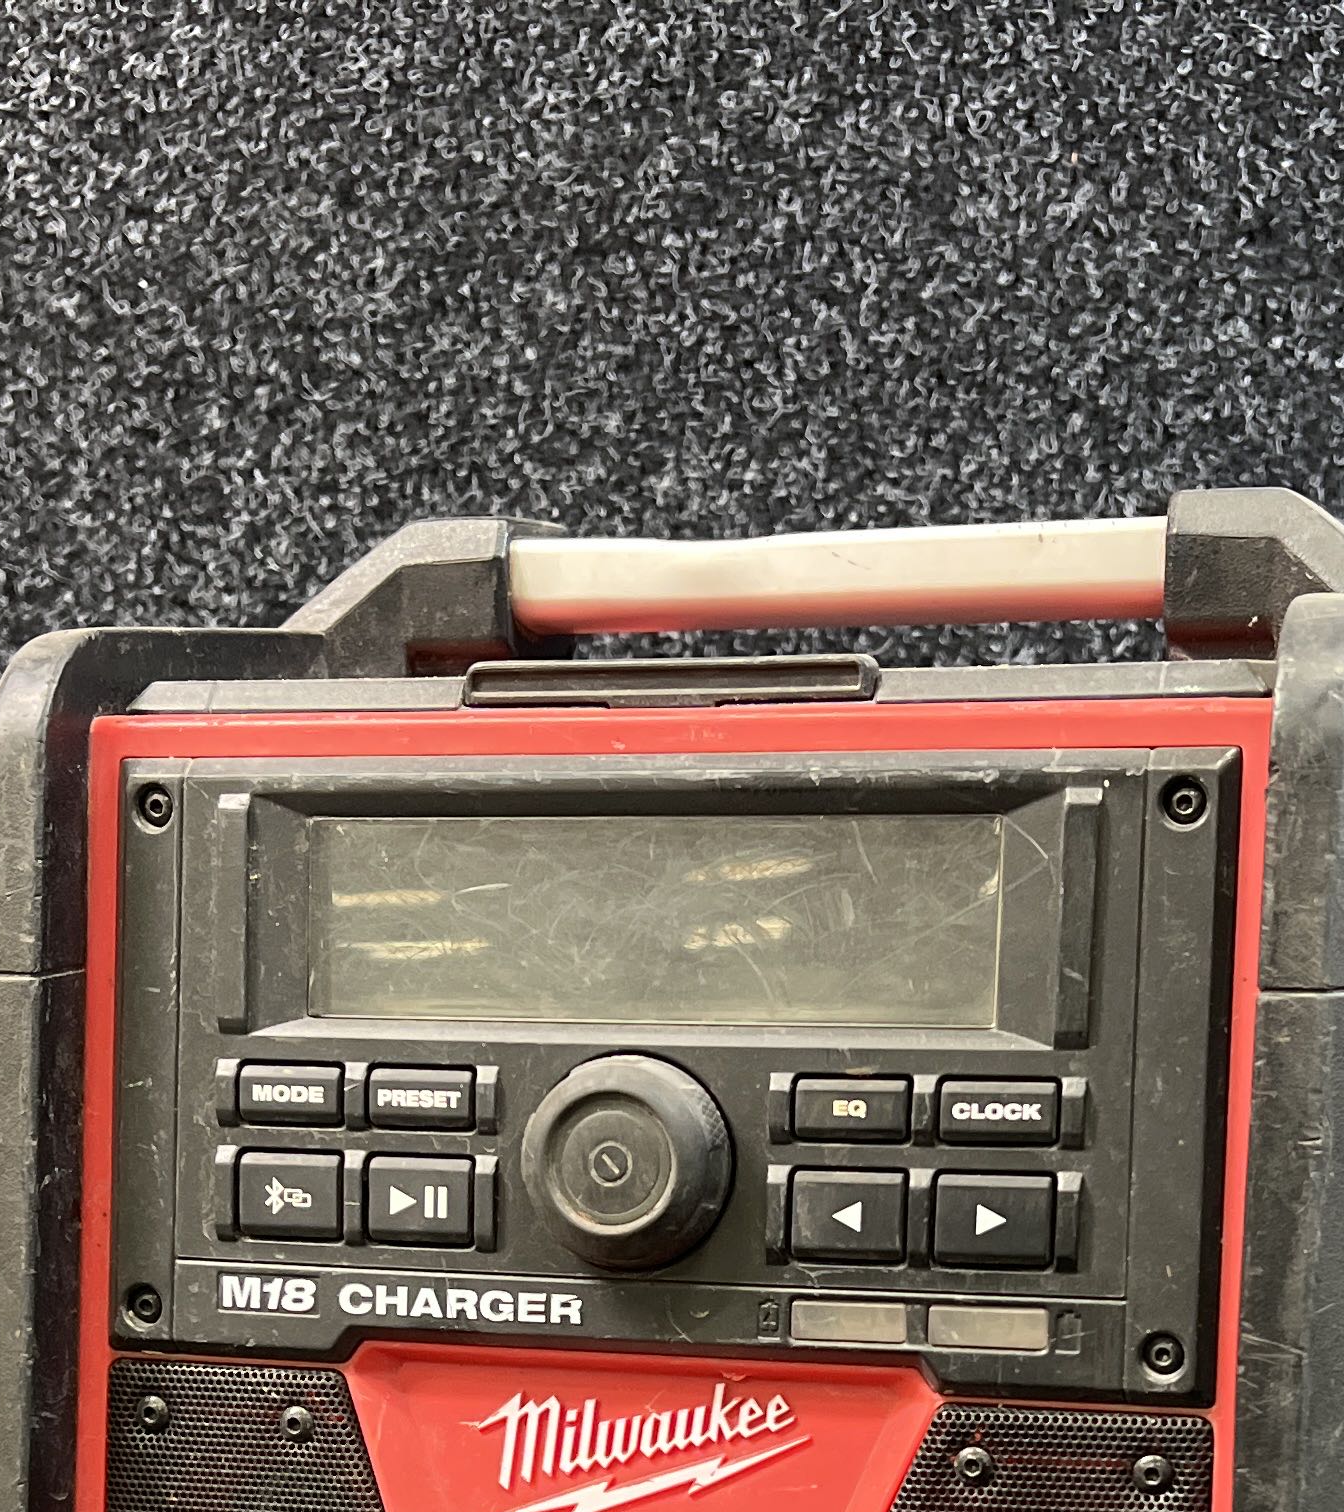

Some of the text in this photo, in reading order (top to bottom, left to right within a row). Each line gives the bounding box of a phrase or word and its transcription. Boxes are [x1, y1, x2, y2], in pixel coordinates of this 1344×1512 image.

[251, 1083, 325, 1104] MODE
[376, 1088, 462, 1109] PRESET
[832, 1099, 867, 1119] EQ
[951, 1102, 1042, 1121] CLOCK
[221, 1274, 583, 1325] M18 CHARGER
[477, 1382, 797, 1491] Milwaukee
